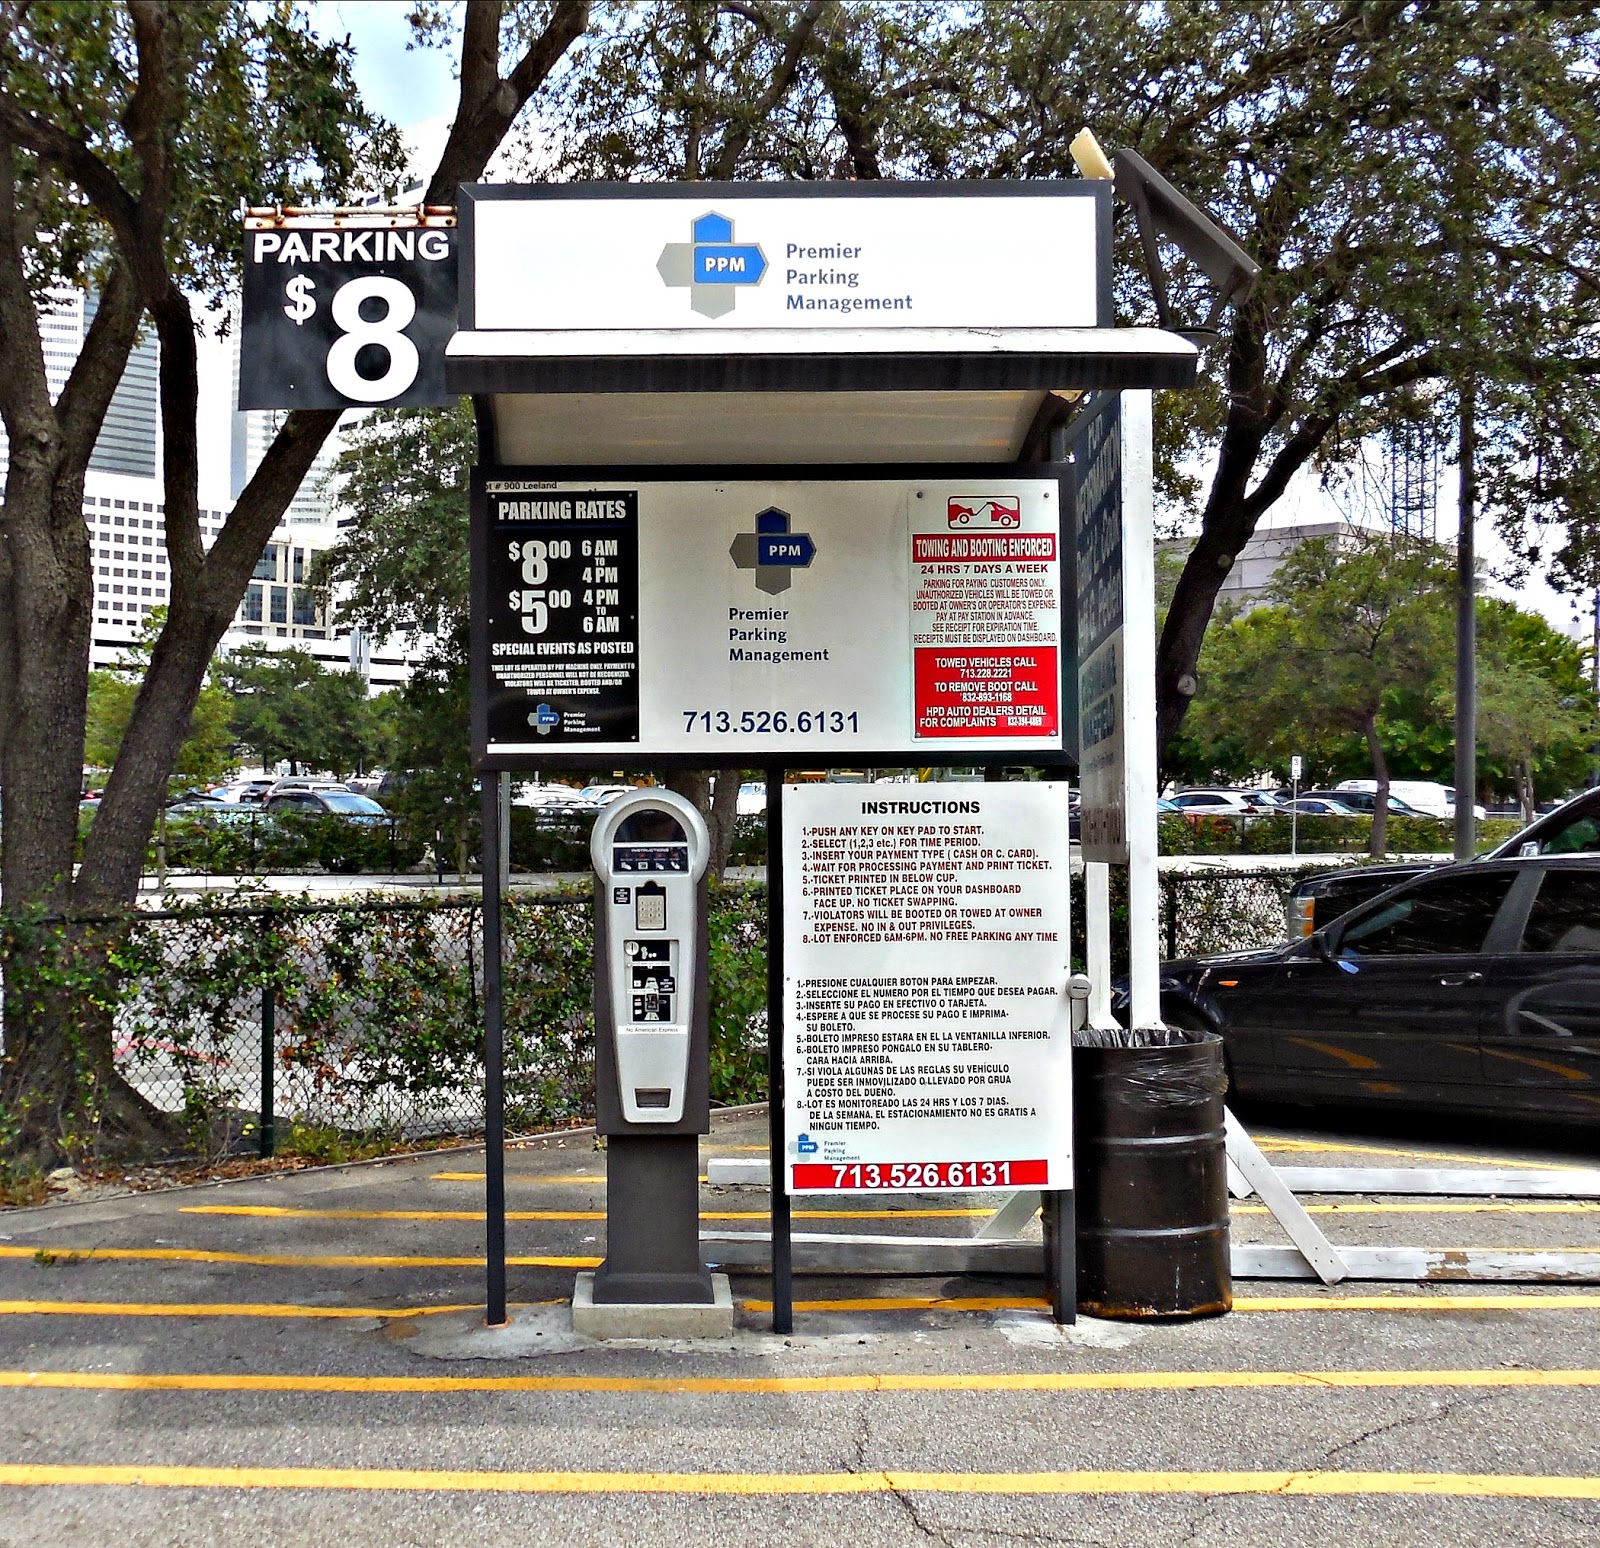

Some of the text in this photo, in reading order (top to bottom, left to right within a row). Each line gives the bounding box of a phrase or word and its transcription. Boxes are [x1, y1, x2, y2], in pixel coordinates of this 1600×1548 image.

[253, 230, 450, 264] PARKING
[787, 243, 861, 259] Premier
[706, 258, 744, 272] PPM
[787, 269, 858, 288] Parking
[787, 294, 912, 313] Management
[504, 482, 520, 490] 900
[523, 482, 558, 490] Leeland
[499, 501, 625, 520] PARKING RATES
[582, 540, 617, 556] 6 AM
[769, 545, 800, 556] PPM
[916, 538, 1053, 557] TOWING AND BOOTING ENFORCED
[595, 557, 604, 566] TO
[921, 564, 1047, 574] 24 HRS 7 DAYS A WEEK
[582, 567, 617, 583] 4 PM
[924, 579, 950, 588] PARKING
[952, 579, 964, 588] FOR
[965, 579, 987, 587] PAYING
[990, 578, 1027, 587] CUSTOMERS
[583, 590, 618, 605] 4 PM
[596, 607, 606, 615] TO
[729, 608, 788, 620] Premier
[583, 617, 618, 633] 6 AM
[932, 623, 944, 632] SEE
[945, 623, 970, 632] RECEIPT
[972, 623, 984, 632] FOR
[986, 622, 1021, 631] EXPIRATION
[729, 628, 786, 643] Parking
[492, 642, 633, 655] SPECIAL EVENTS AS POSTED
[729, 649, 828, 663] Management
[935, 658, 1036, 667] TOWED VEHICLES CALL
[960, 669, 1011, 678] 713.228.2221
[934, 682, 1037, 692] TO REMOVE BOOT CALL
[926, 706, 1046, 716] HPD AUTO DEALERS DETAIL
[683, 711, 857, 733] 713.526.6131
[920, 718, 996, 727] FOR COMPLAINTS
[862, 802, 979, 813] INSTRUCTIONS
[839, 827, 857, 835] ANY
[860, 826, 878, 835] KEY
[881, 826, 893, 835] ON
[897, 826, 914, 835] KEY
[917, 826, 935, 835] PAD
[938, 826, 950, 835] TO
[953, 826, 983, 834] START.
[876, 839, 895, 847] etc.)
[900, 839, 916, 847] FOR
[920, 838, 941, 847] TIME
[944, 838, 980, 847] PERIOD.
[838, 863, 855, 871] FOR
[859, 862, 916, 871] PROCESSING
[920, 862, 962, 871] PAYMENT
[965, 862, 983, 870] AND
[987, 862, 1013, 870] PRINT
[1016, 861, 1051, 870] TICKET.
[848, 875, 886, 883] PRINTED
[890, 875, 898, 883] IN
[902, 874, 933, 883] BELOW
[936, 874, 957, 882] CUP.
[855, 886, 886, 895] TICKET
[890, 886, 918, 895] PLACE
[921, 886, 933, 894] ON
[937, 886, 962, 894] YOUR
[965, 885, 1020, 894] DASHBOARD
[850, 978, 897, 987] CUALQUIER
[900, 978, 928, 986] BOTON
[931, 978, 953, 986] PARA
[956, 977, 997, 986] EMPEZAR.
[861, 990, 870, 998] EL
[873, 990, 908, 998] NUMERO
[911, 989, 928, 997] POR
[931, 989, 940, 997] EL
[943, 989, 974, 997] TIEMPO
[978, 988, 994, 997] QUE
[998, 988, 1024, 996] DESEA
[1027, 988, 1057, 996] PAGAR.
[896, 1001, 936, 1009] EFECTIVO
[948, 1000, 986, 1008] TARJETA.
[806, 1056, 892, 1064] CARA HACIA ARRIBA.
[809, 1122, 879, 1130] NINGUN TIEMPO.
[832, 1163, 1009, 1188] 713.526.6131
